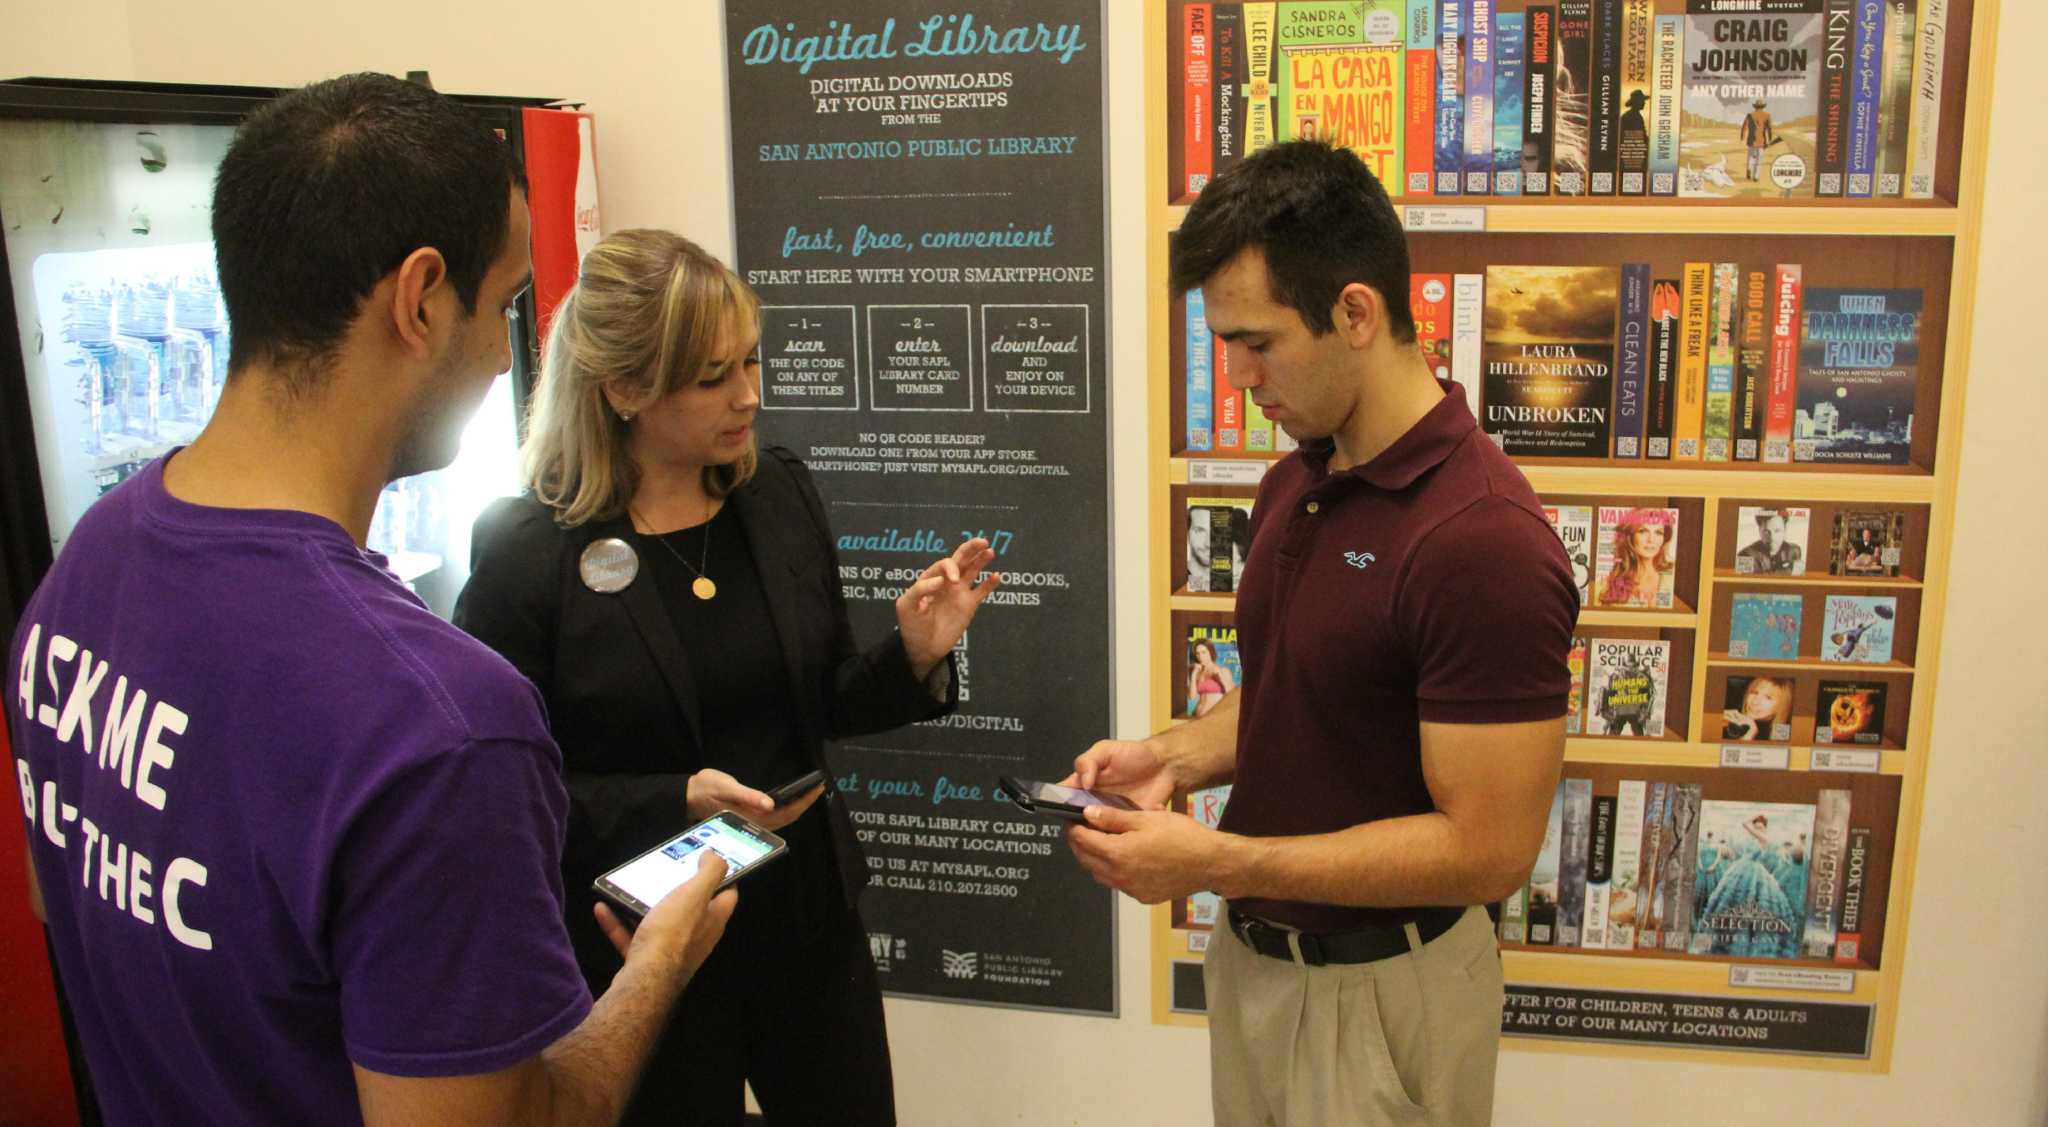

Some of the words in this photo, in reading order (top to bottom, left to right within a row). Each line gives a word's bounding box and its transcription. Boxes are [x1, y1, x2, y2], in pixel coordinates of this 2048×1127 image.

[1291, 10, 1346, 23] SANDRA
[1442, 2, 1458, 28] MARY
[1473, 0, 1489, 35] GHOST
[1711, 0, 1762, 11] LONGMIRE
[1253, 21, 1267, 42] LEE
[1281, 24, 1356, 39] CISNEROS
[1532, 12, 1549, 63] SUSPICION
[1560, 21, 1589, 30] GONE
[1564, 30, 1584, 38] GIRL
[1714, 18, 1789, 43] CRAIG
[742, 17, 897, 74] Digital
[904, 13, 1087, 64] Library
[1442, 32, 1458, 69] HIGGINS
[1472, 38, 1488, 62] SHIP
[1628, 0, 1638, 81] MEGAPACK
[1637, 0, 1649, 82] WESTERN
[1827, 10, 1850, 69] KING
[1220, 46, 1233, 68] Kill
[1252, 45, 1267, 77] CHILD
[1659, 40, 1675, 90] RACKETEER
[1692, 48, 1808, 73] JOHNSON
[1920, 23, 1944, 102] GOLDFINCH
[810, 77, 884, 95] DIGITAL
[887, 72, 1013, 92] DOWNLOADS
[1220, 71, 1232, 81] A
[1293, 59, 1326, 90] LA
[1332, 56, 1393, 90] CASA
[1442, 71, 1457, 102] CLARK
[1531, 73, 1545, 102] JOSEPH
[1601, 75, 1611, 115] GILLIAN
[1692, 84, 1719, 98] ANY
[1720, 84, 1764, 98] OTHER
[1766, 84, 1807, 98] NAME
[815, 97, 843, 113] AT
[848, 95, 896, 112] YOUR
[900, 92, 1008, 110] FINGERTIPS
[1659, 96, 1672, 117] JOHN
[881, 115, 914, 125] FROM
[917, 114, 941, 124] THE
[1218, 84, 1233, 157] Mockingbird
[1296, 94, 1317, 112] EN
[1322, 91, 1394, 148] MANGO
[1530, 104, 1544, 134] FINDER
[1600, 119, 1609, 151] FLYNN
[1656, 119, 1671, 160] GRISHAM
[1825, 103, 1841, 162] SHINING
[759, 144, 800, 161] SAN
[805, 141, 901, 160] ANTONIO
[907, 139, 982, 157] PUBLIC
[988, 136, 1076, 156] LIBRARY
[782, 226, 842, 258] fast,
[852, 224, 914, 256] free,
[921, 223, 1055, 249] convenient
[748, 270, 801, 285] START
[805, 270, 852, 284] HERE
[856, 269, 904, 283] WITH
[909, 268, 960, 283] YOUR
[964, 267, 1094, 283] SMARTPHONE
[1691, 269, 1705, 296] THINK
[1748, 272, 1765, 308] GOOD
[1689, 299, 1703, 318] LIKE
[1775, 273, 1797, 337] Juicing
[1840, 295, 1887, 313] WHEN
[1746, 311, 1764, 343] CALL
[1808, 312, 1915, 341] DARKNESS
[784, 341, 826, 353] scan
[895, 339, 942, 353] enter
[991, 335, 1079, 353] download
[1521, 345, 1577, 358] LAURA
[1624, 321, 1640, 374] CLEAN
[1687, 328, 1700, 357] FREAK
[1824, 340, 1895, 368] FALLS
[769, 358, 793, 368] THE
[813, 358, 845, 368] CODE
[888, 356, 919, 367] YOUR
[922, 356, 951, 366] SAPL
[1022, 357, 1048, 367] AND
[1489, 362, 1609, 377] HILLENBRAND
[777, 371, 794, 382] ON
[796, 371, 820, 382] ANY
[823, 372, 838, 382] OF
[879, 370, 925, 380] LIBRARY
[928, 370, 960, 380] CARD
[1006, 371, 1043, 382] ENJOY
[1046, 371, 1064, 381] ON
[772, 385, 806, 396] THESE
[809, 385, 844, 396] TITLES
[896, 384, 944, 394] NUMBER
[995, 385, 1028, 395] YOUR
[1031, 384, 1076, 396] DEVICE
[1621, 380, 1637, 417] EATS
[1224, 396, 1235, 424] Wild
[1488, 405, 1607, 424] UNBROKEN
[1744, 391, 1754, 429] ROBERTSON
[859, 433, 877, 444] NO
[898, 433, 932, 444] CODE
[934, 434, 985, 445] READER?
[810, 446, 876, 457] DOWNLOAD
[878, 447, 903, 458] ONE
[905, 448, 937, 459] FROM
[939, 448, 972, 460] YOUR
[973, 449, 996, 460] APP
[883, 461, 909, 474] JUST
[910, 462, 939, 474] VISIT
[837, 528, 948, 552] available
[1562, 526, 1586, 543] FUN
[861, 567, 882, 579] OF
[1598, 644, 1663, 657] POPULAR
[1612, 677, 1649, 690] HUMANS
[1608, 693, 1649, 707] UNIVERSE
[18, 623, 109, 755] ASK
[98, 674, 189, 811] ME
[868, 779, 924, 797] your
[933, 776, 984, 805] free
[889, 814, 926, 828] SAPL
[928, 817, 989, 832] LIBRARY
[992, 821, 1035, 836] CARD
[1039, 824, 1060, 838] AT
[857, 830, 877, 842] OF
[879, 832, 911, 845] OUR
[914, 834, 959, 849] MANY
[962, 837, 1052, 856] LOCATIONS
[888, 857, 907, 871] US
[909, 860, 929, 873] AT
[932, 862, 1030, 880] MYSAPL.ORG
[1815, 827, 1842, 932] DIVERGENT
[1849, 848, 1865, 892] BOOK
[887, 877, 925, 891] CALL
[928, 879, 1018, 898] 210.207.2500
[1702, 916, 1792, 933] SELECTION
[1842, 893, 1860, 932] THIEF
[1006, 955, 1052, 965] ANTONIO
[984, 974, 1050, 986] FOUNDATION
[1545, 996, 1577, 1009] FOR
[1581, 998, 1668, 1017] CHILDREN,
[1672, 1004, 1724, 1018] TEENS
[1728, 1007, 1740, 1019] &
[1743, 1008, 1808, 1023] ADULTS
[1518, 1013, 1551, 1026] ANY
[1555, 1015, 1577, 1028] OF
[1582, 1017, 1615, 1030] OUR
[1619, 1019, 1669, 1034] MANY
[1672, 1022, 1768, 1039] LOCATIONS
